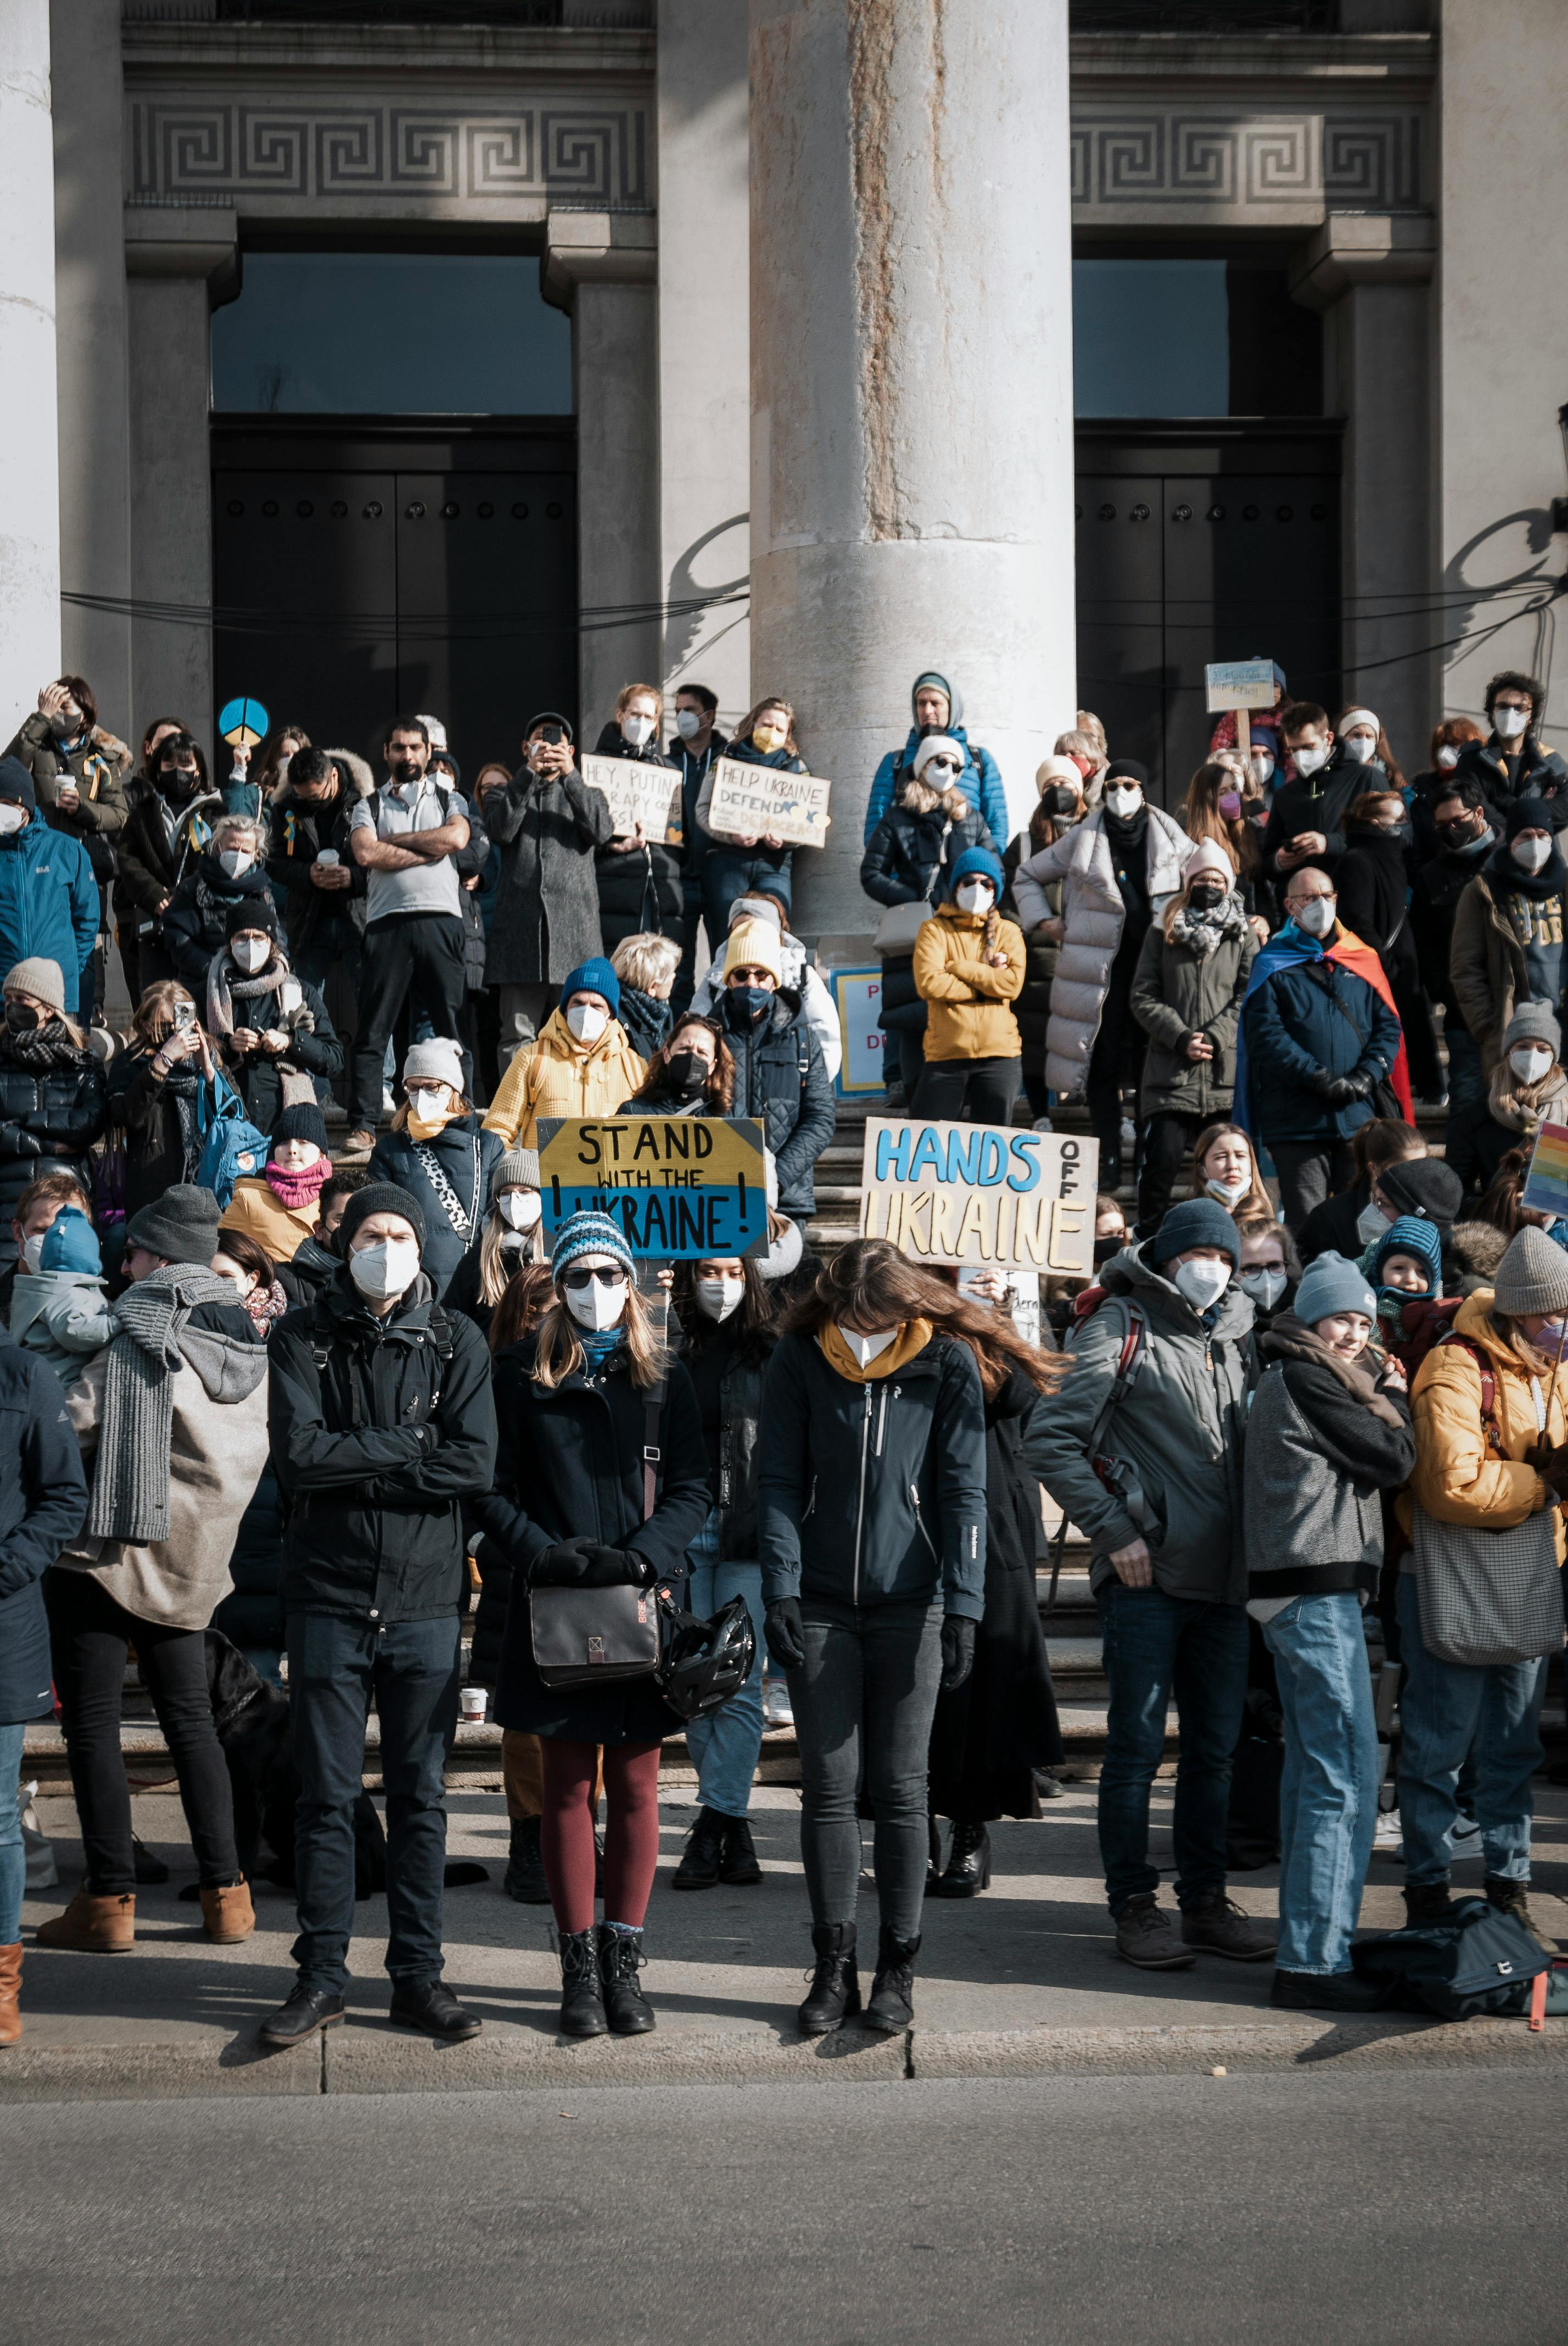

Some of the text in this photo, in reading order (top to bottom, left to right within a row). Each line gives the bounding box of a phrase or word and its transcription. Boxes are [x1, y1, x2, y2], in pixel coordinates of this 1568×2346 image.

[586, 763, 620, 789] HEY,
[722, 765, 824, 805] HELP UKRAINE
[610, 791, 651, 816] RAPY
[720, 789, 783, 814] DEFEND
[611, 808, 634, 829] SS!
[740, 812, 822, 840] DEMOCRACY
[577, 1122, 713, 1164] STAND
[875, 1126, 1080, 1199] HANDS OFF
[597, 1168, 704, 1191] WITH THE
[865, 1189, 1087, 1271] UKRAINE
